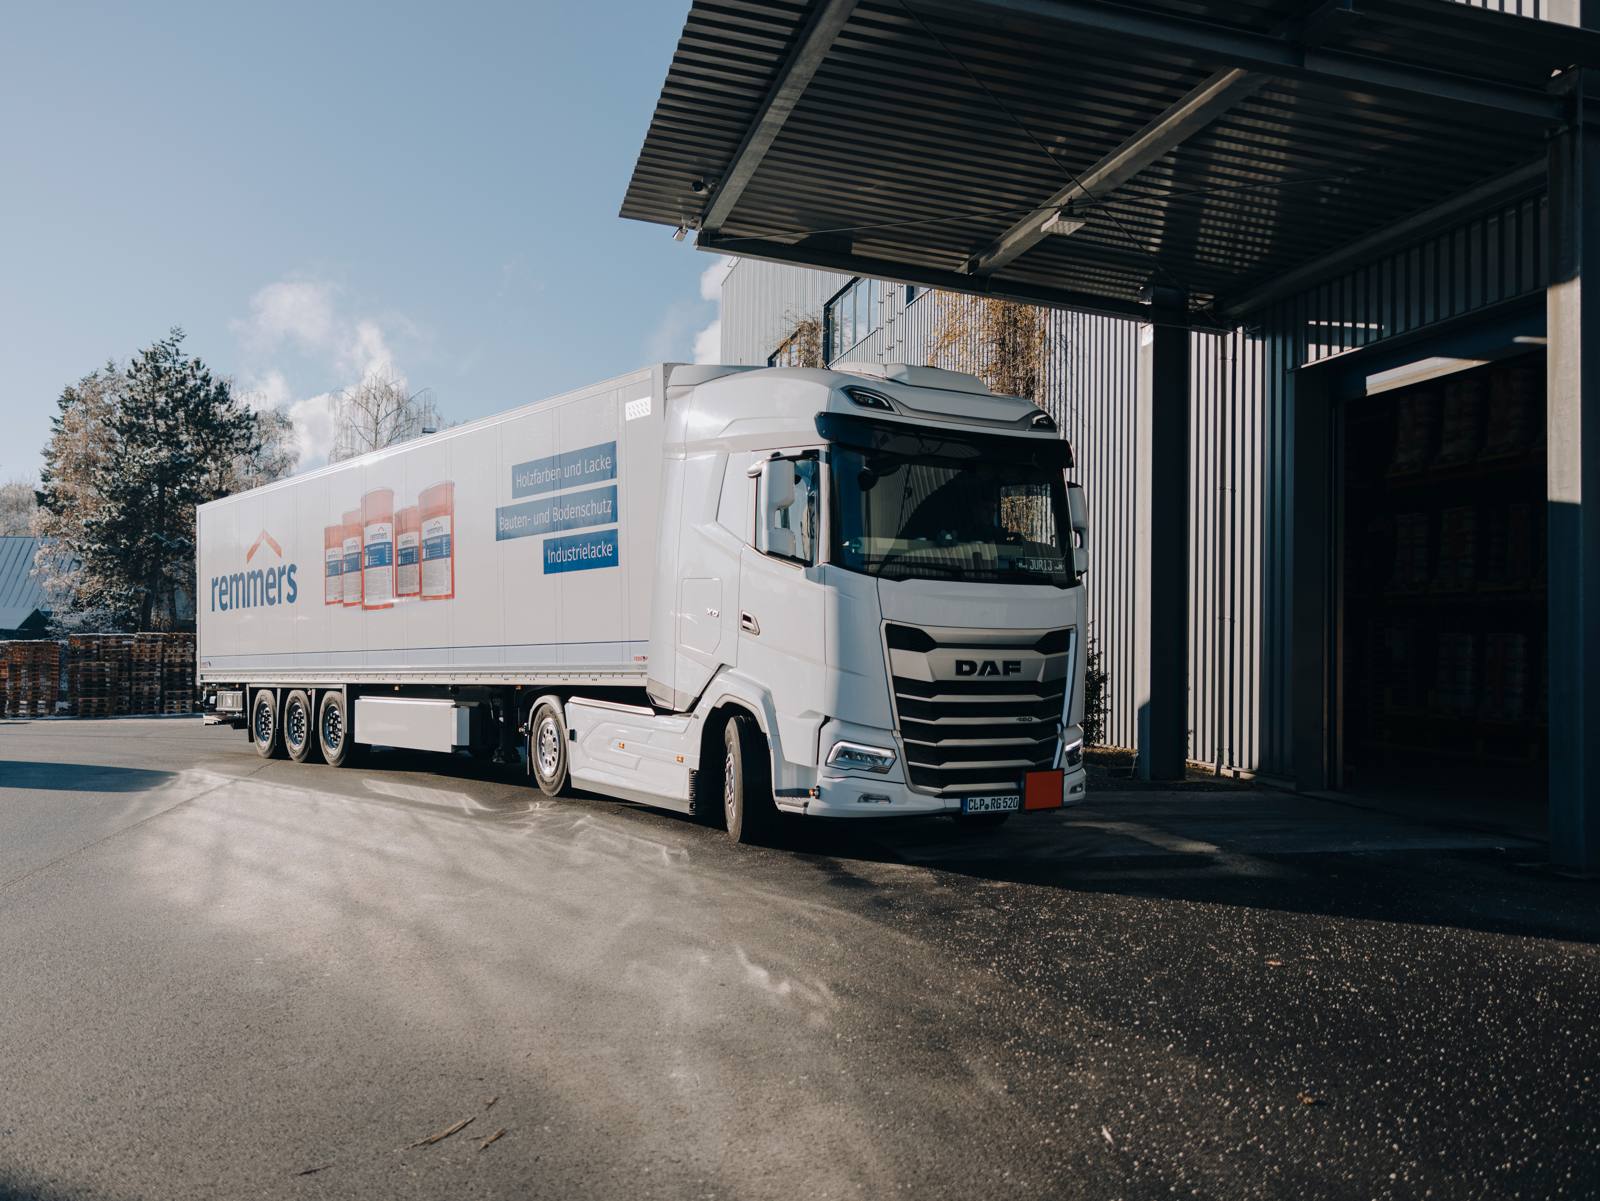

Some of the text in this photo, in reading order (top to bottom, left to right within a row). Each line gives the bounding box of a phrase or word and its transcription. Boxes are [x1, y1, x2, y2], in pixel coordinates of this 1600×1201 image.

[516, 454, 611, 489] Holzfarben und Lacke
[500, 499, 612, 531] Bauten- und Bodenschutz
[547, 541, 613, 564] Industrielacke
[1030, 559, 1053, 571] JURIJ
[211, 563, 298, 612] remmers
[955, 659, 1022, 677] DAF
[1002, 797, 1018, 809] 520
